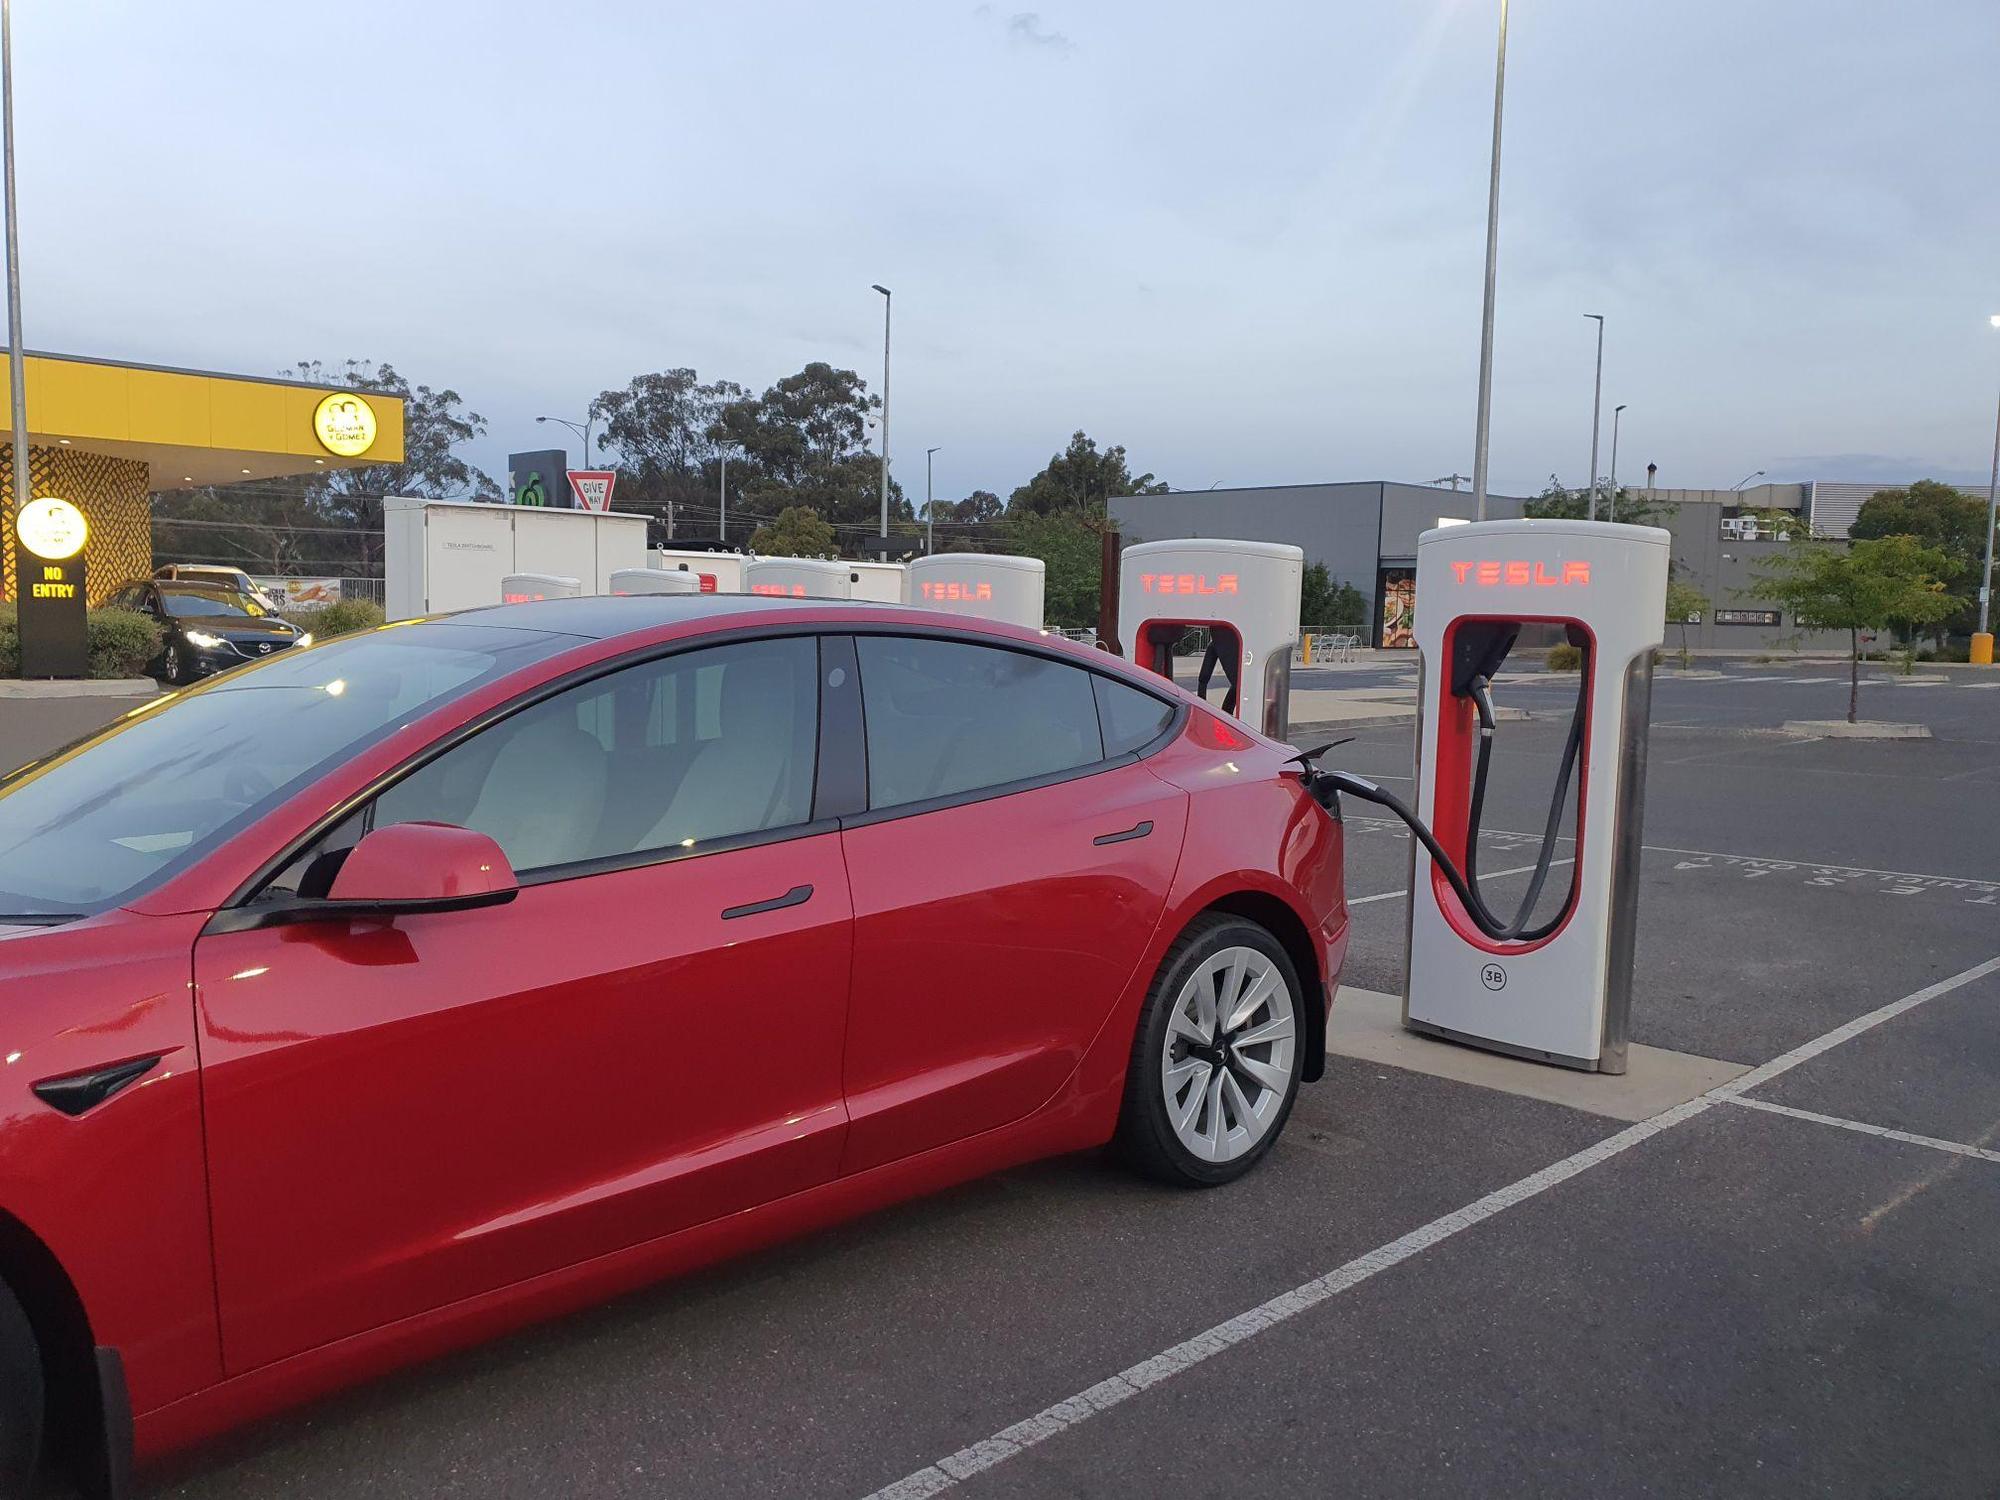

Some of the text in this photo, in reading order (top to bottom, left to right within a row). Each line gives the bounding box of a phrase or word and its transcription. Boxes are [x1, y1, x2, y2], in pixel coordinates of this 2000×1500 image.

[583, 482, 604, 494] GIVE
[589, 496, 601, 504] WAY
[44, 567, 62, 580] NO
[1451, 561, 1591, 584] TESLA
[33, 584, 74, 597] ENTRY
[1141, 575, 1238, 593] TESLA
[921, 582, 992, 600] TESLA
[1486, 970, 1502, 982] 3B
